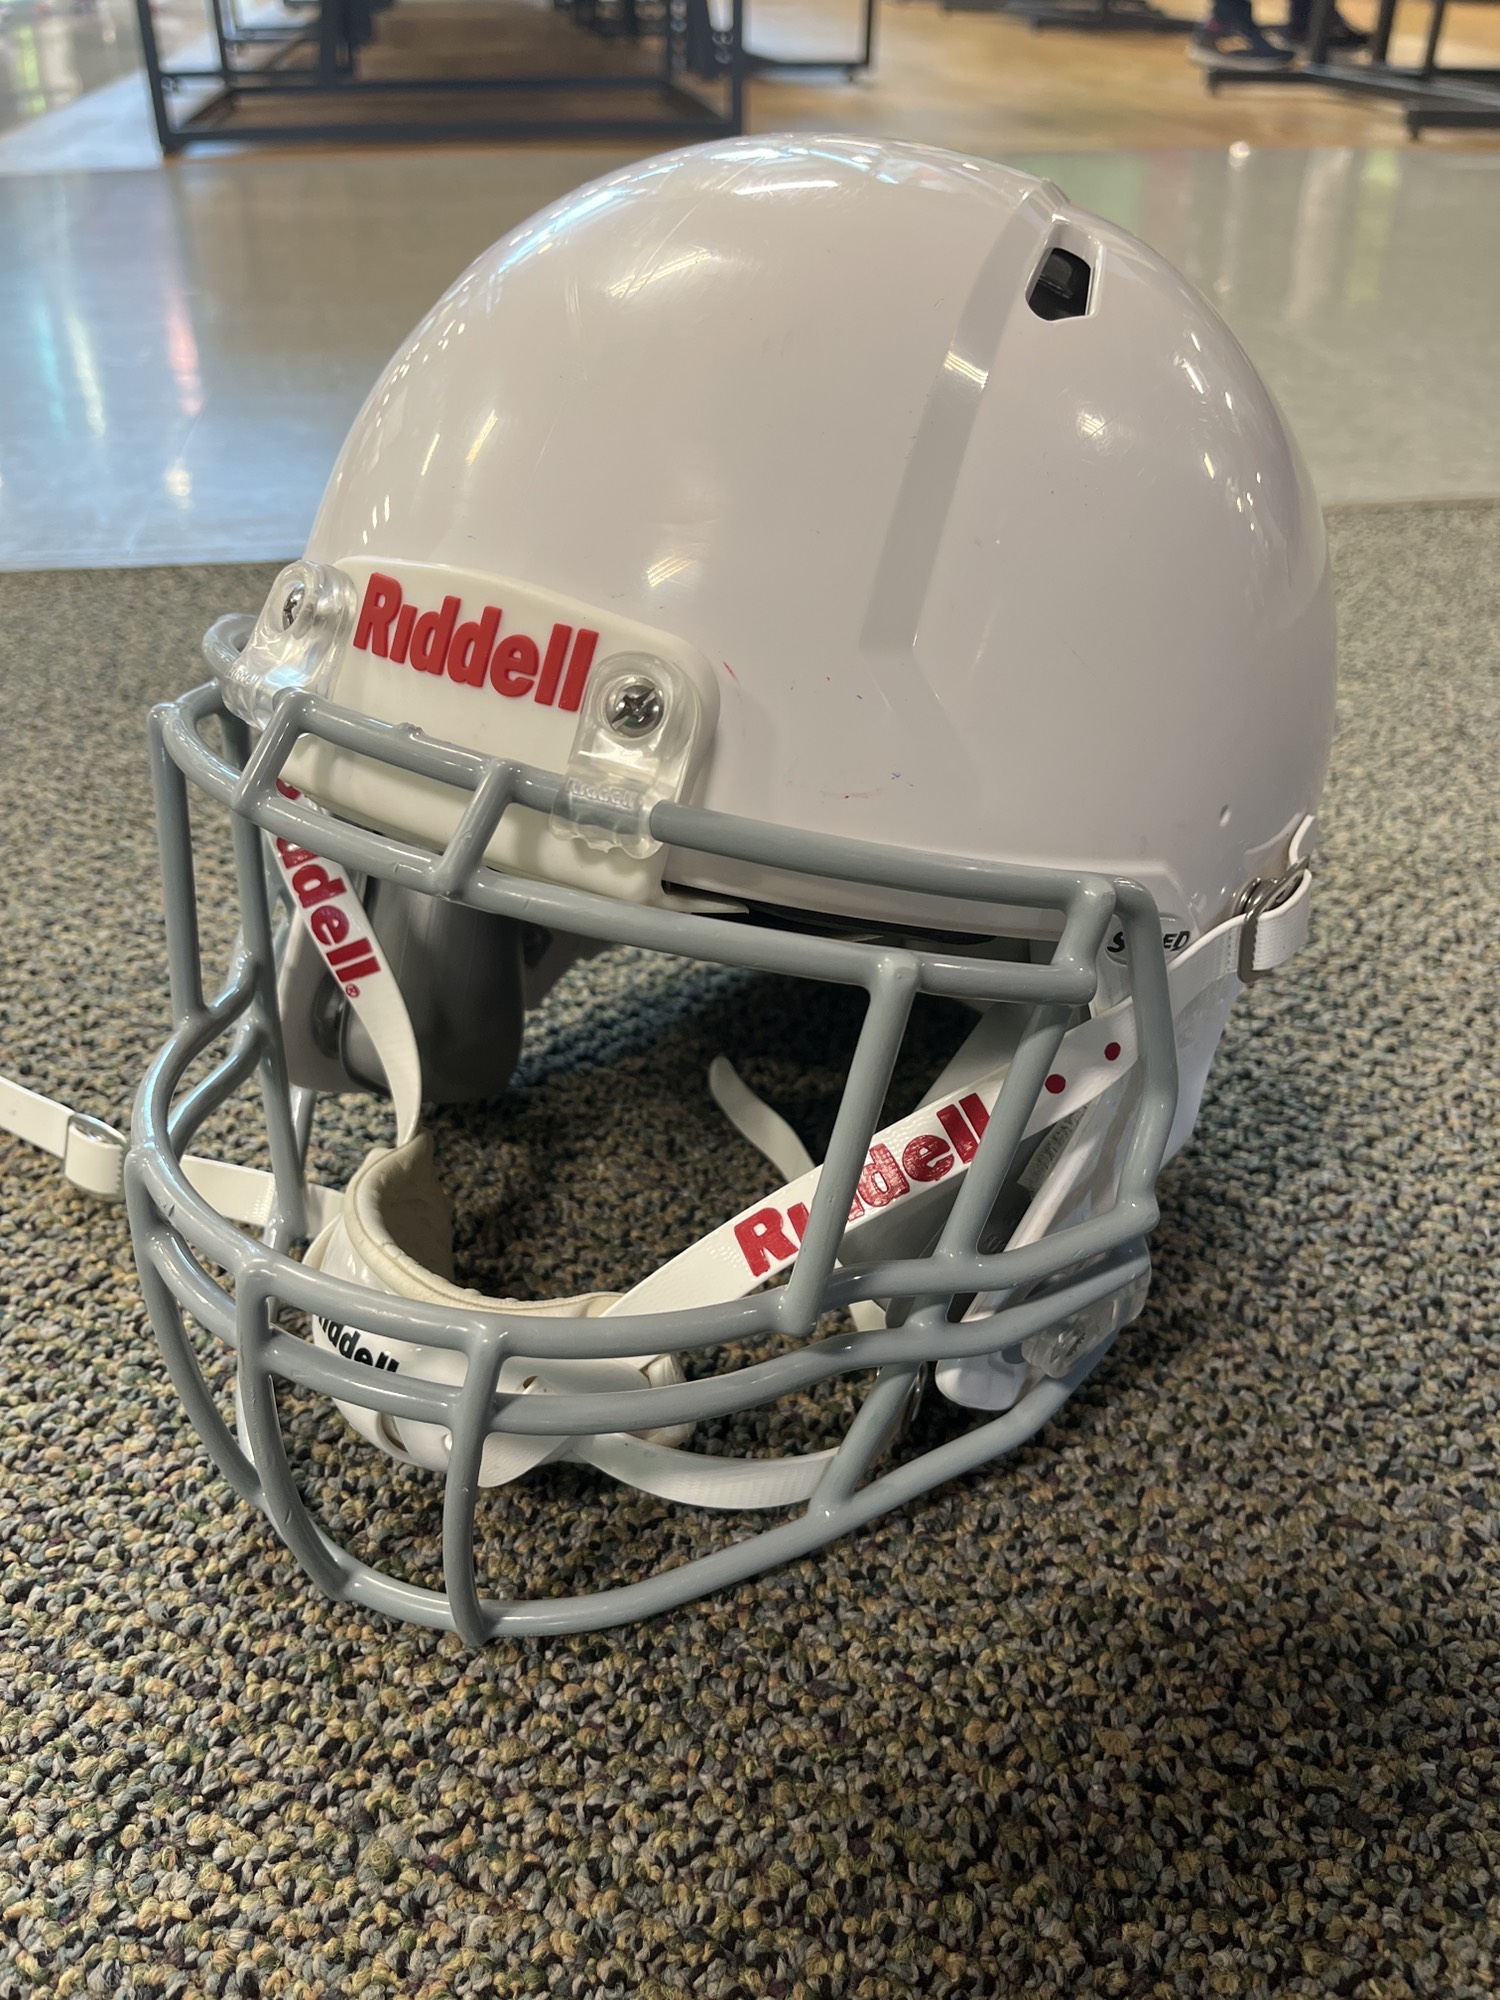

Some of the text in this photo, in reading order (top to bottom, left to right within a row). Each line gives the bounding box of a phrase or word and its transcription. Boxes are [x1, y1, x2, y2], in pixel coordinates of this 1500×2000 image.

[353, 571, 600, 712] Riddell
[1106, 930, 1190, 953] SED
[734, 1093, 990, 1277] Ridell
